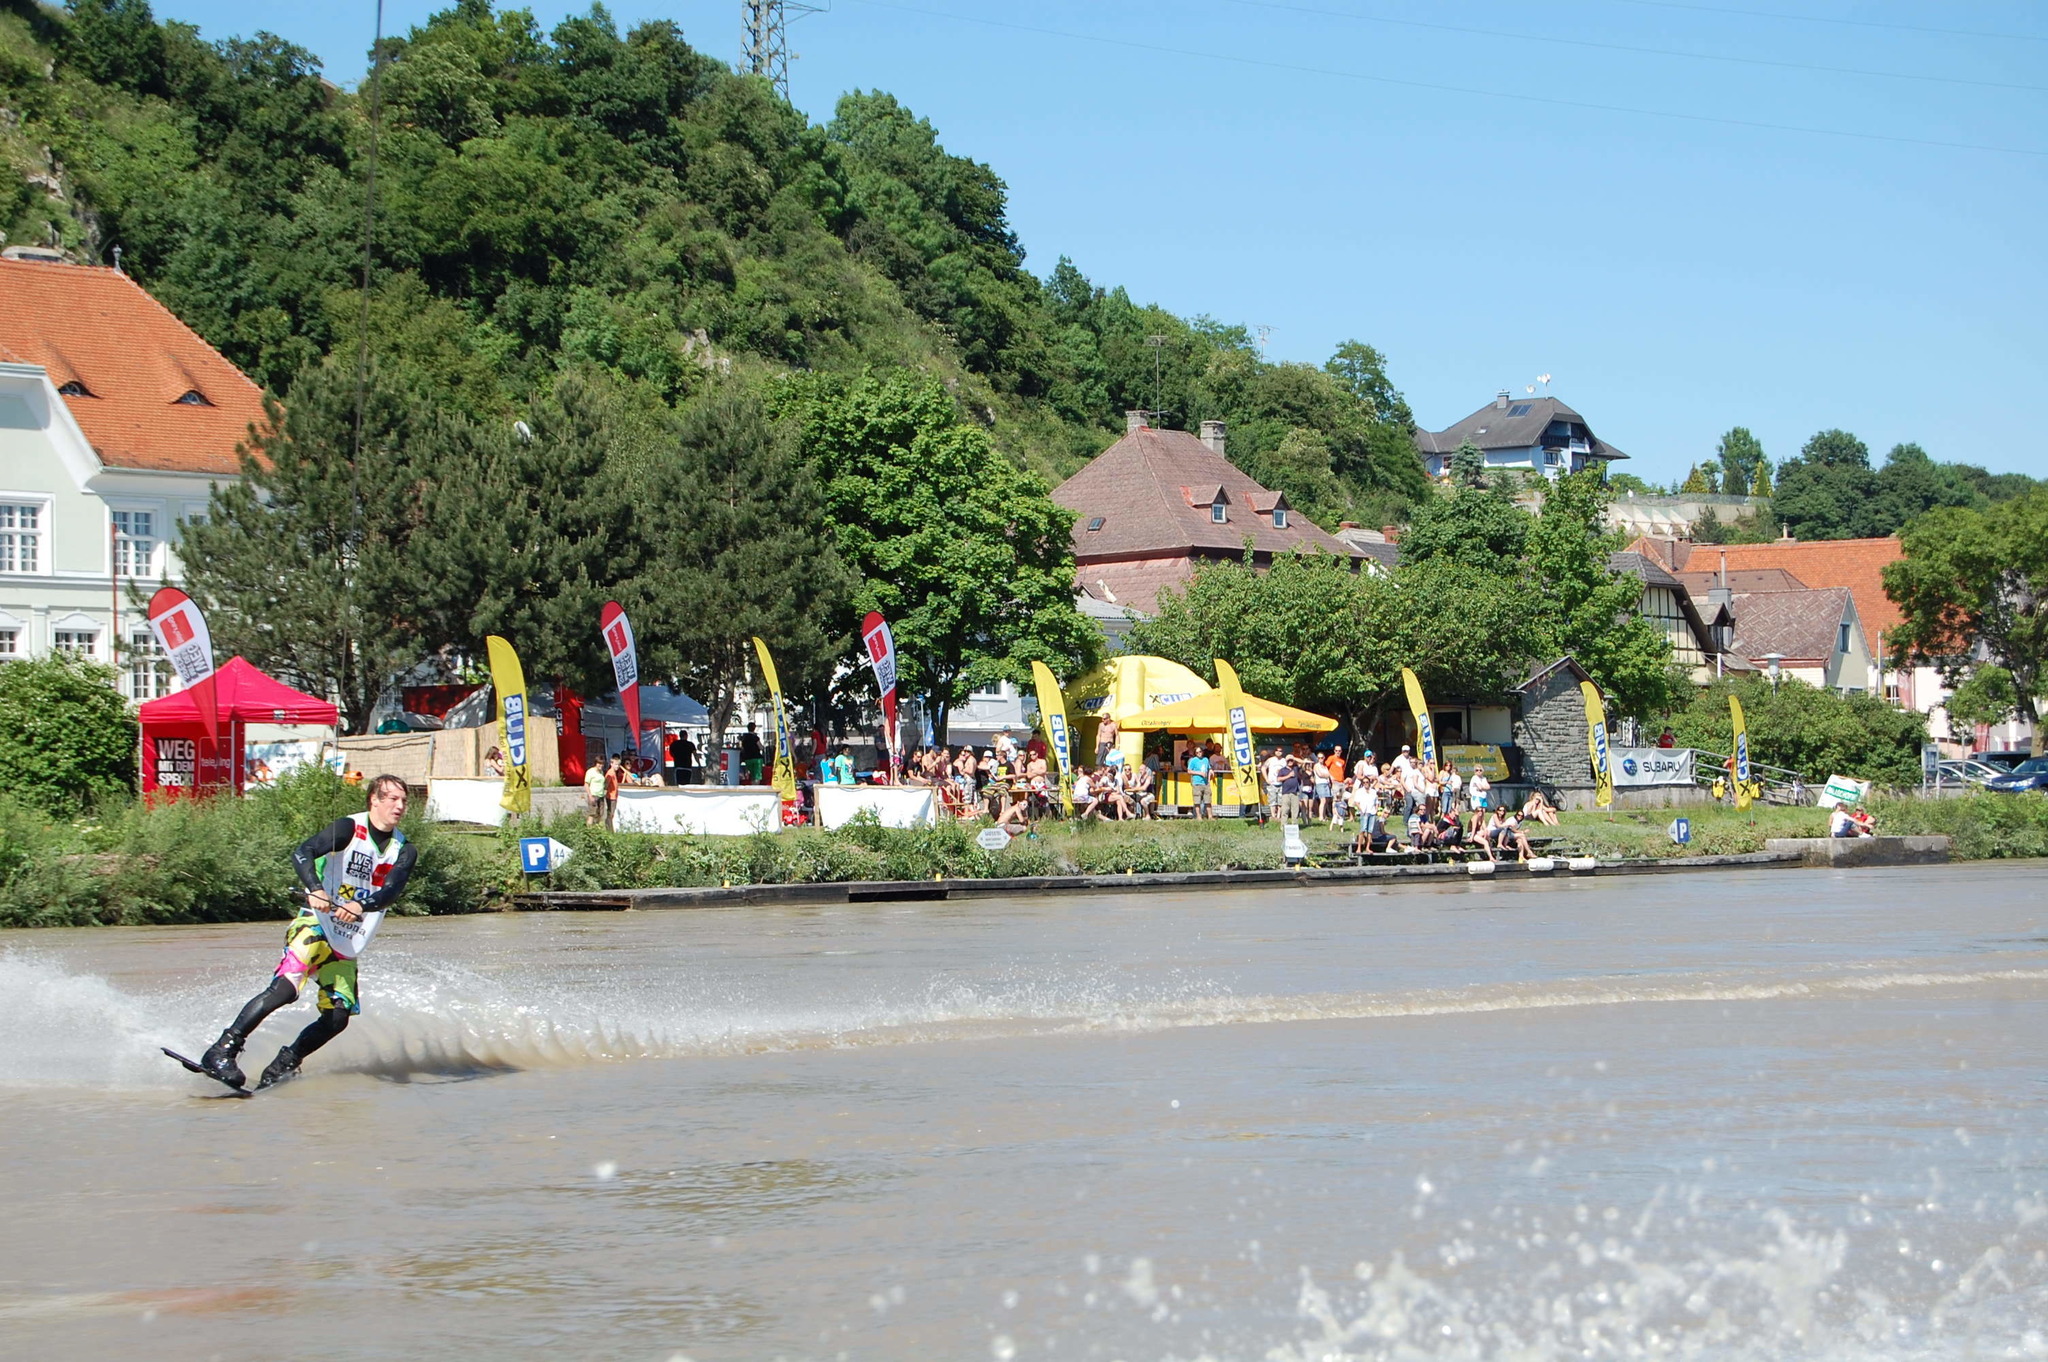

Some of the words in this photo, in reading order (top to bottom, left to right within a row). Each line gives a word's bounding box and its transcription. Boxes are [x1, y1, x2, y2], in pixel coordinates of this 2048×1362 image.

[1084, 696, 1112, 710] CLUB
[158, 740, 195, 760] WEG
[158, 761, 174, 772] MIT
[175, 761, 194, 772] DEM
[1643, 762, 1681, 773] SUBARU
[1680, 822, 1687, 839] P
[527, 843, 546, 866] P
[554, 849, 565, 858] 44
[330, 916, 366, 937] Corona
[333, 925, 353, 940] Extra
